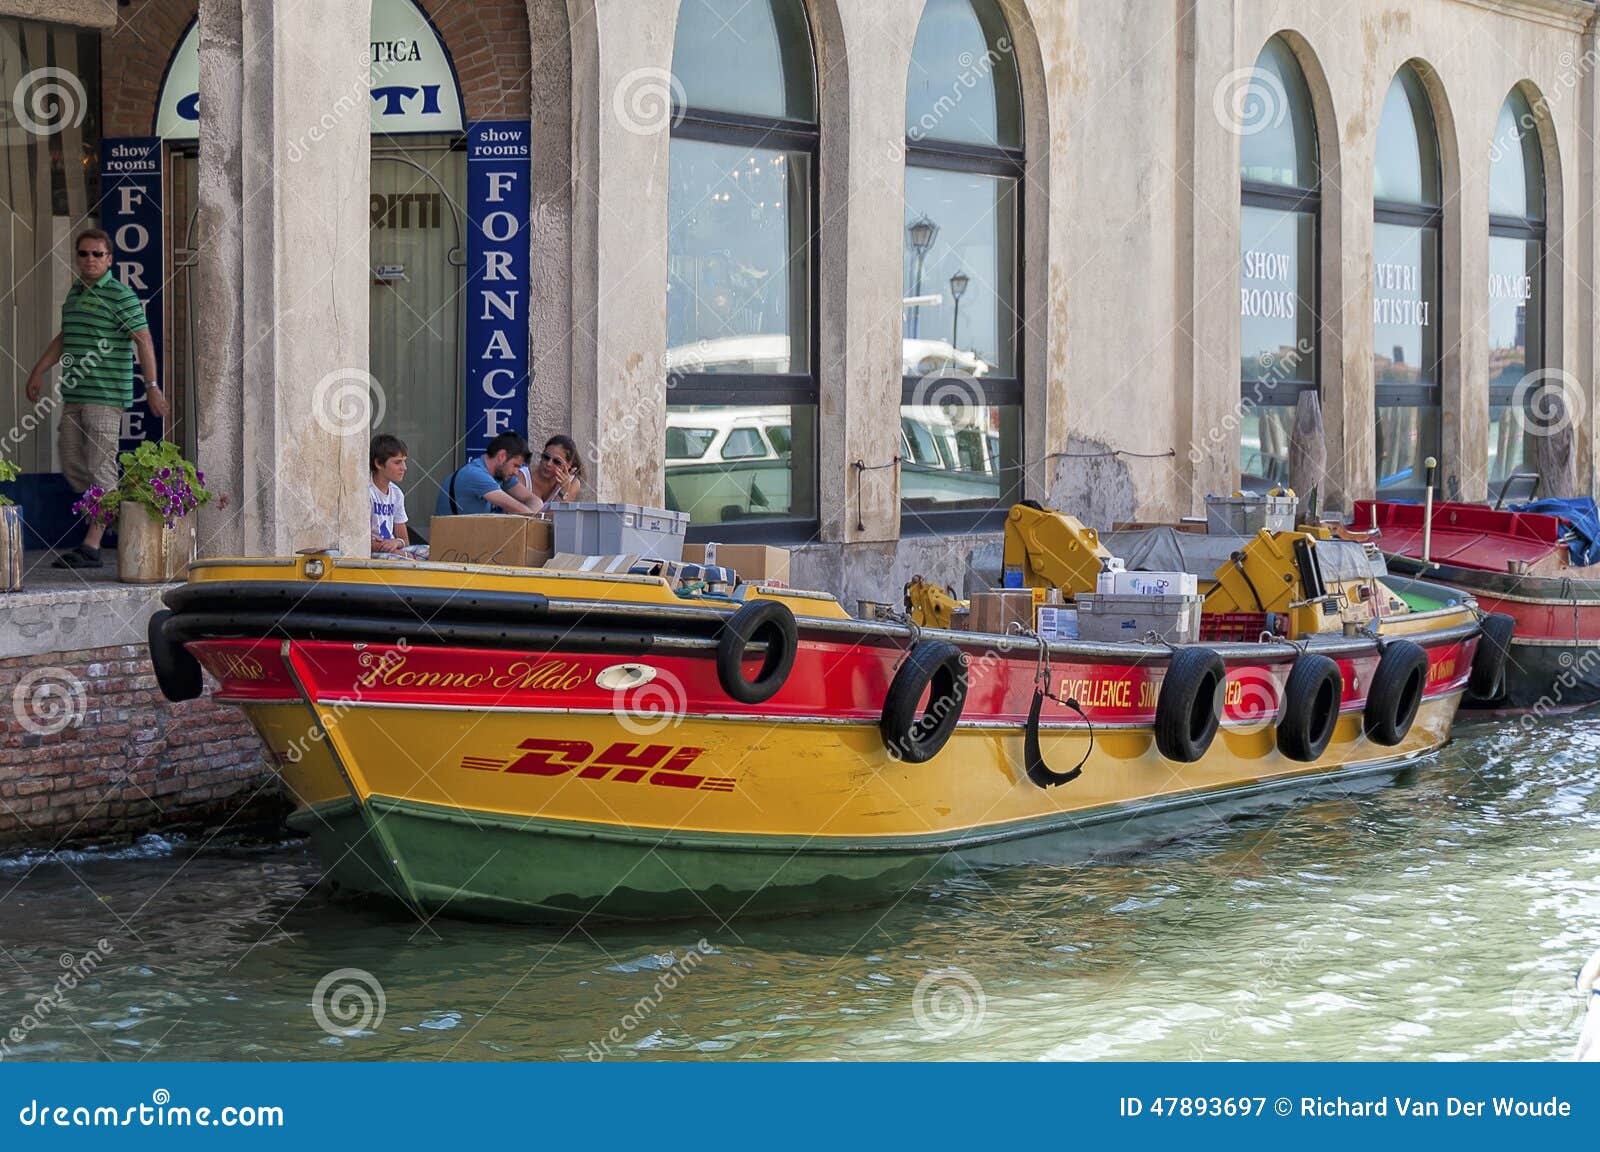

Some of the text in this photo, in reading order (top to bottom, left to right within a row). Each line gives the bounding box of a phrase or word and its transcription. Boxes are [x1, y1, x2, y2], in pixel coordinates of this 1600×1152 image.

[479, 128, 522, 142] show
[111, 144, 150, 158] show
[474, 144, 528, 156] rooms
[107, 159, 156, 171] rooms
[1245, 250, 1290, 281] SHOW
[1377, 263, 1417, 292] VETRI
[1240, 287, 1295, 320] ROOMS
[503, 737, 707, 790] DHL
